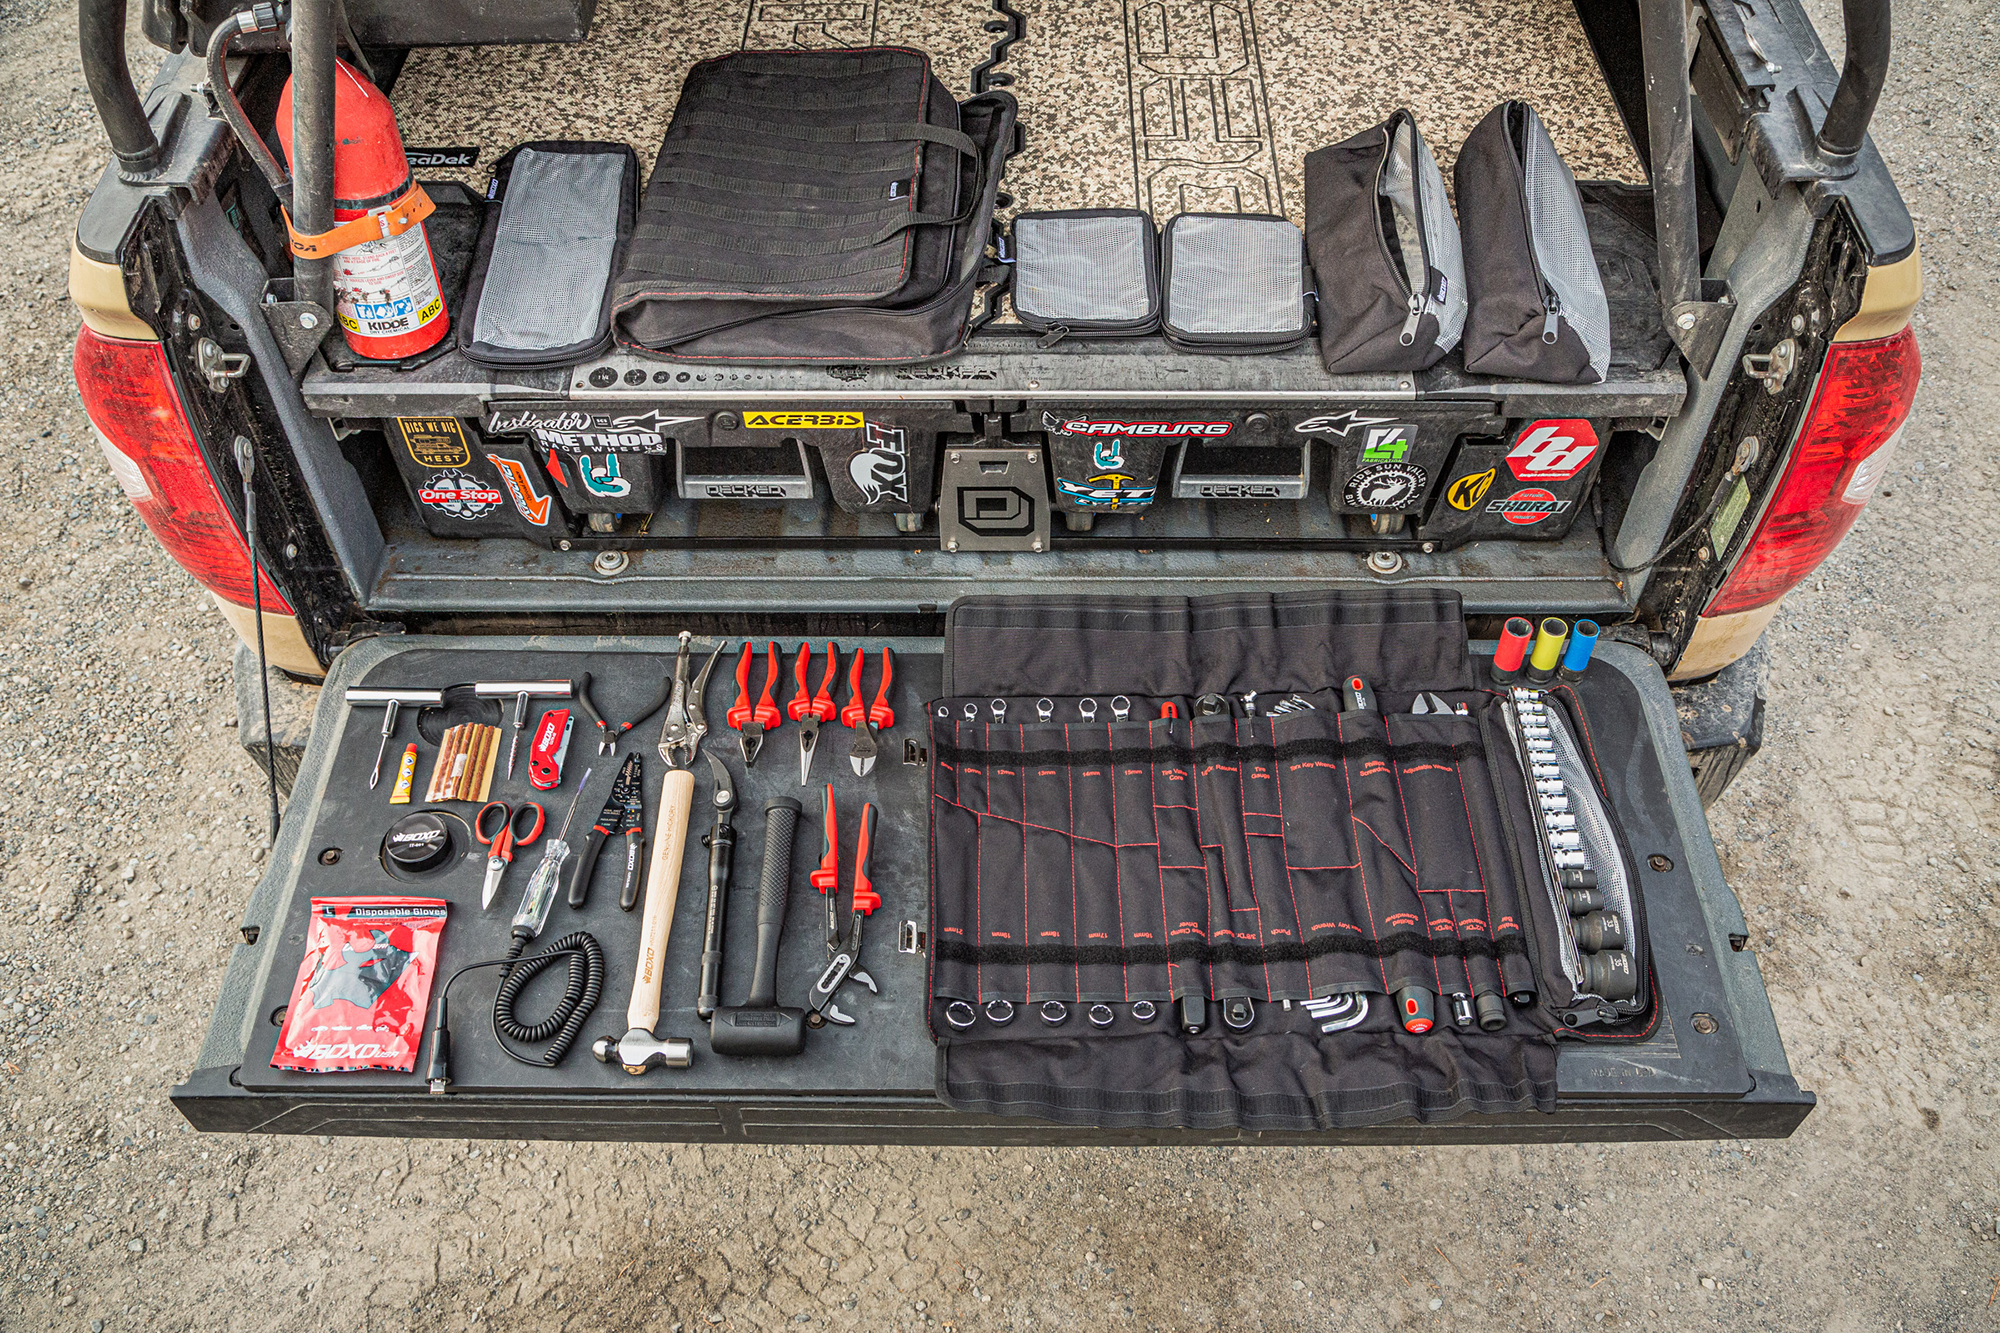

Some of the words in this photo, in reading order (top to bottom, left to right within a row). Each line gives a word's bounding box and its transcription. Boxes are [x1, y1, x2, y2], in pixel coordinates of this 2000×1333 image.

[405, 152, 471, 165] eaDek
[421, 298, 441, 321] ABC
[367, 317, 409, 331] KIDDE
[747, 414, 861, 426] ACERBIS
[425, 421, 440, 433] WE
[440, 421, 457, 434] DIG
[1064, 421, 1230, 435] CAMBURG
[535, 428, 663, 447] METHOD
[541, 440, 582, 453] RACE
[592, 443, 664, 453] WHEELS
[858, 422, 908, 504] FOX
[1349, 469, 1372, 488] RIDE
[1375, 463, 1401, 472] SUN
[1406, 465, 1427, 487] VALLEY
[421, 490, 457, 500] One
[460, 490, 499, 502] Stop
[706, 484, 787, 498] DECKED
[1201, 485, 1280, 497] DECKED
[1487, 500, 1569, 512] SHORAI
[542, 723, 555, 746] BOXO
[1314, 761, 1336, 770] Wrench
[1364, 760, 1386, 769] Phillips
[1403, 764, 1433, 774] Adjustable
[1432, 764, 1453, 772] Wrench
[963, 767, 982, 775] 10mm
[403, 829, 441, 841] BOXO
[627, 849, 637, 871] BOXO
[355, 908, 411, 917] Disposable
[413, 908, 446, 917] Gloves
[1311, 922, 1336, 932] Wrench
[1338, 921, 1351, 930] Key
[1606, 919, 1614, 928] 33
[944, 927, 963, 935] 21mm
[1170, 928, 1190, 936] Clamp
[1270, 928, 1291, 936] Punch
[644, 947, 656, 977] BOXO
[1614, 958, 1622, 968] 35
[313, 1043, 381, 1060] BOXO
[375, 1051, 399, 1059] USA
[1591, 1067, 1618, 1077] MADE
[1622, 1068, 1632, 1077] IN
